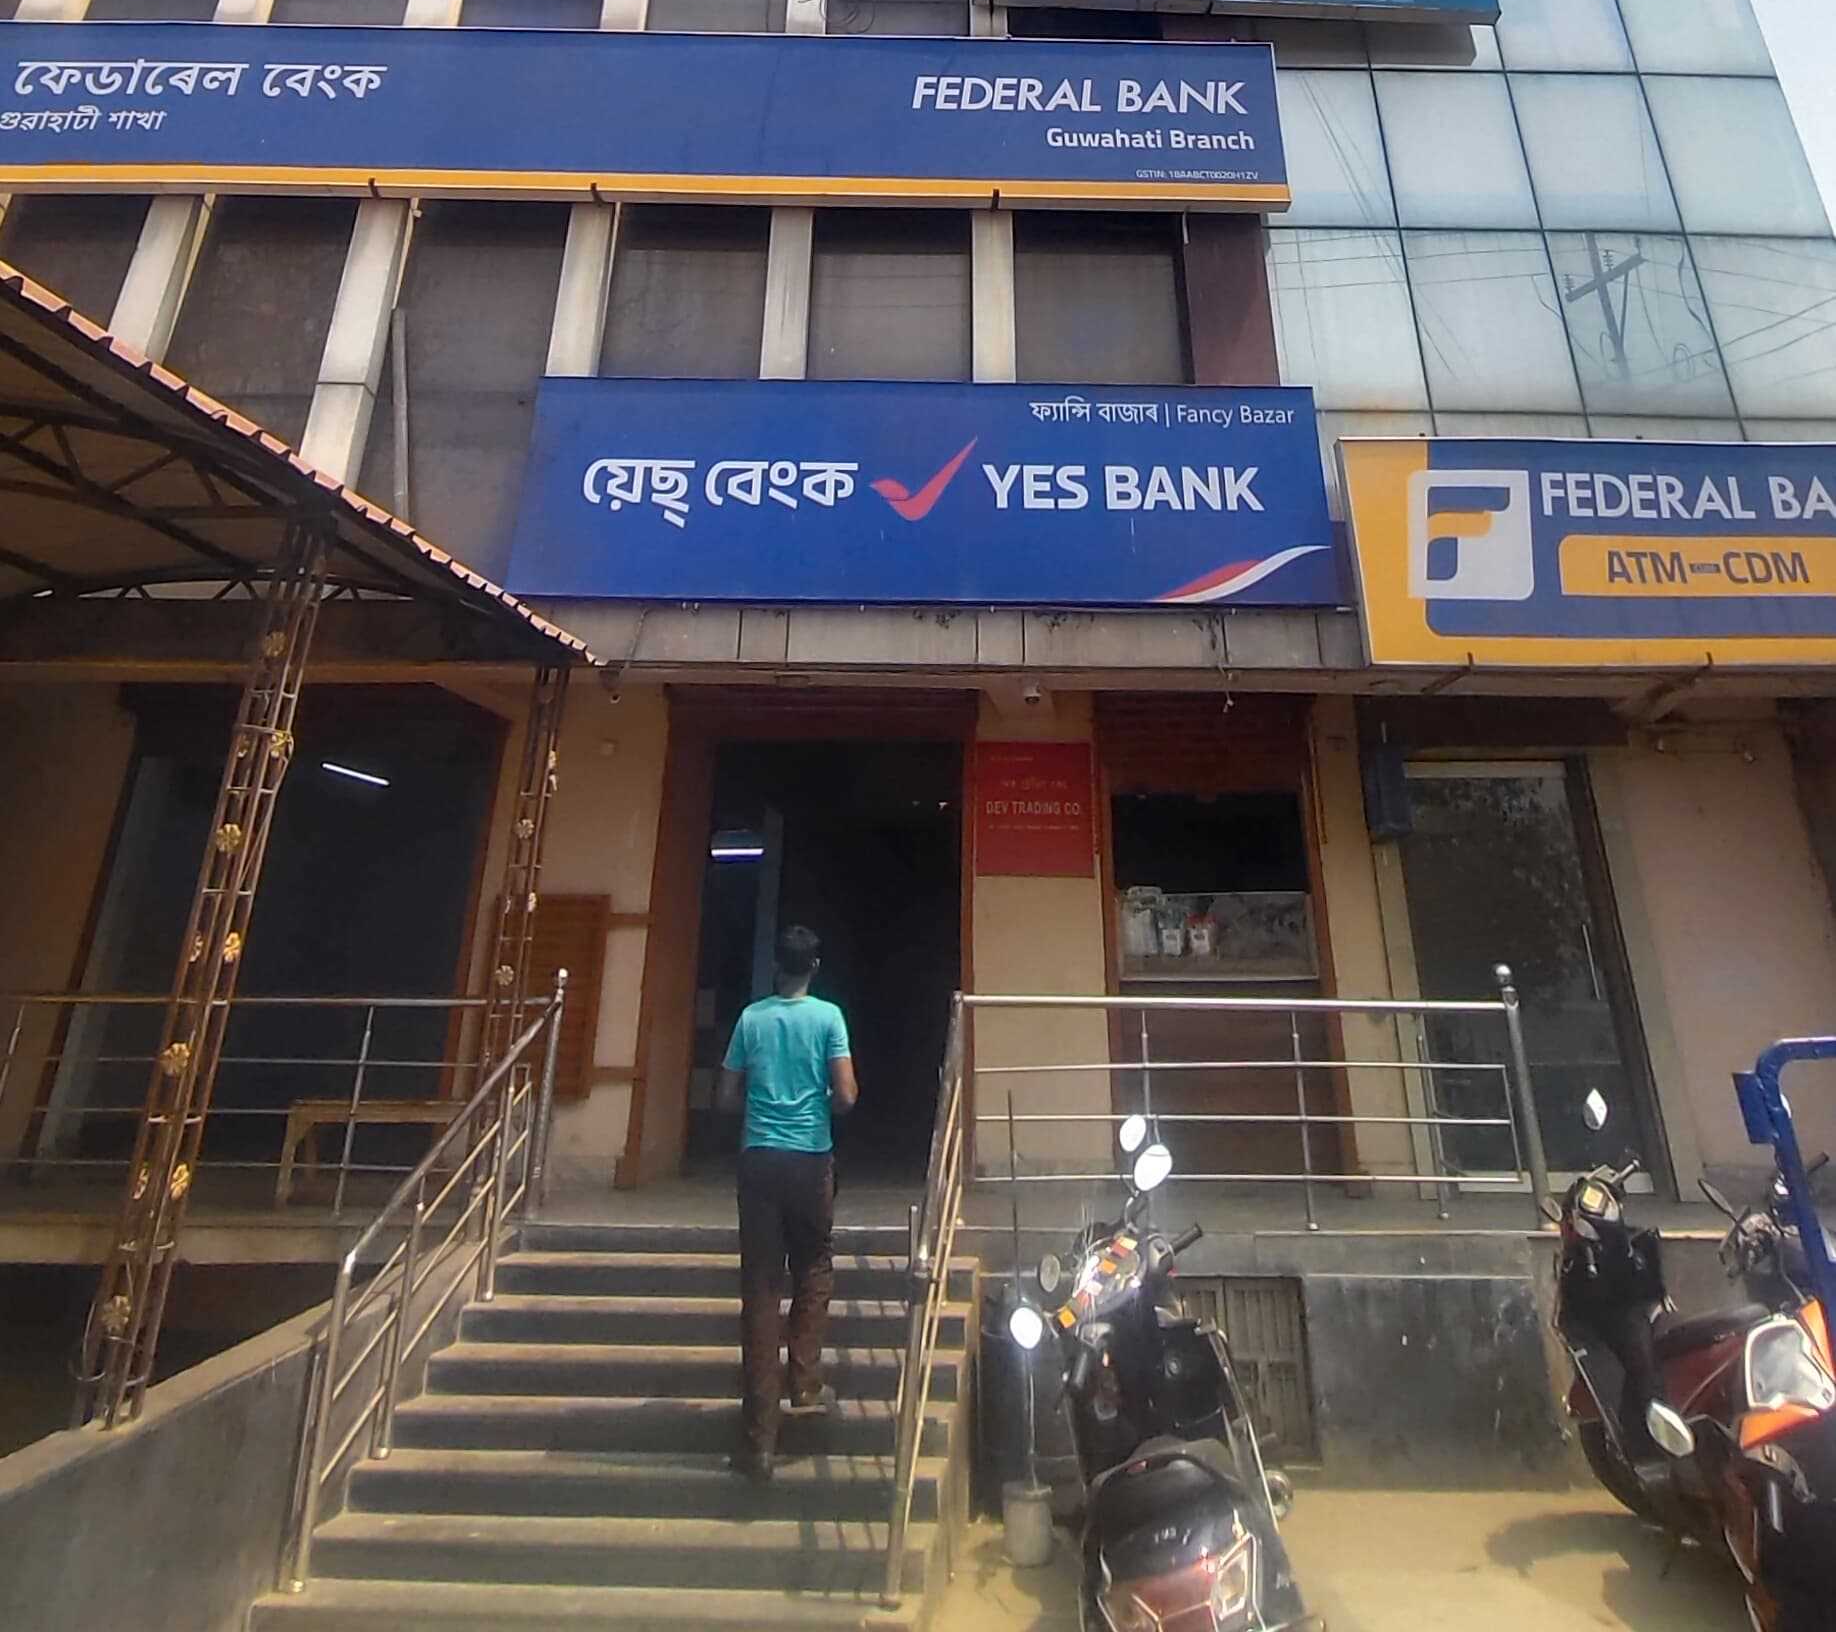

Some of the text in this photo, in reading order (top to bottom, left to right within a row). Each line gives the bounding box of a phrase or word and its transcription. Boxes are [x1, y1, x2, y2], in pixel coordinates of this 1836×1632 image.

[14, 58, 388, 100] ফেডাৰেল বেংক
[912, 76, 1248, 115] FEDERAL BANK
[108, 110, 168, 131] শাখা
[1046, 127, 1255, 151] Guwahati Branch
[1096, 402, 1159, 425] বাজাৰ
[1177, 404, 1295, 428] Fancy Bazar
[704, 460, 859, 510] বেংক
[982, 463, 1266, 513] YES BANK
[1540, 471, 1758, 520] FEDERAL
